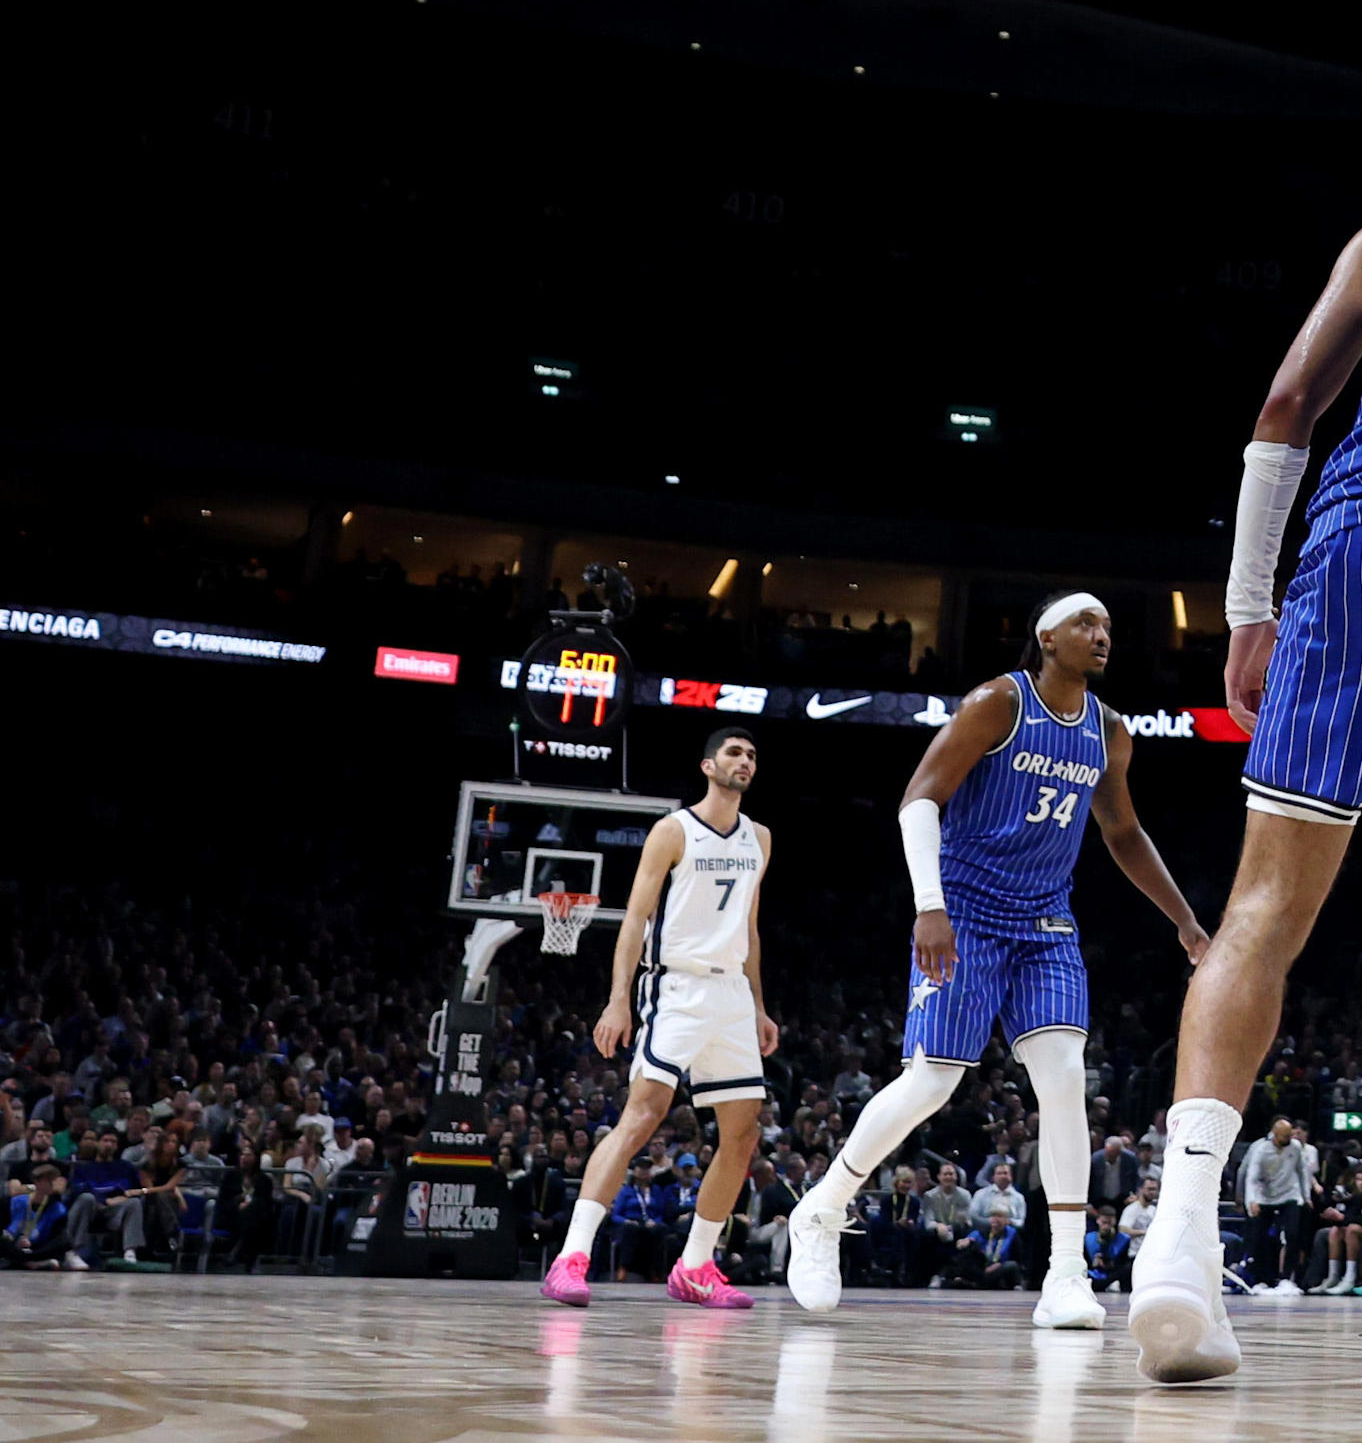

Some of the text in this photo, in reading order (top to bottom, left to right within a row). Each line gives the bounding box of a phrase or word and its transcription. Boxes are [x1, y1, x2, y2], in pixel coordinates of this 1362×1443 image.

[383, 653, 450, 676] Emirates
[673, 678, 768, 715] 2K26
[1121, 709, 1195, 738] volut
[547, 741, 612, 761] TISSOT
[1025, 785, 1079, 829] 34
[695, 858, 757, 871] MEMPHIS
[715, 878, 736, 911] 7
[459, 1033, 483, 1053] GET
[457, 1052, 480, 1072] THE
[431, 1131, 487, 1145] TISSOT
[431, 1183, 476, 1206] BERLIN
[428, 1206, 499, 1231] GAME 2026
